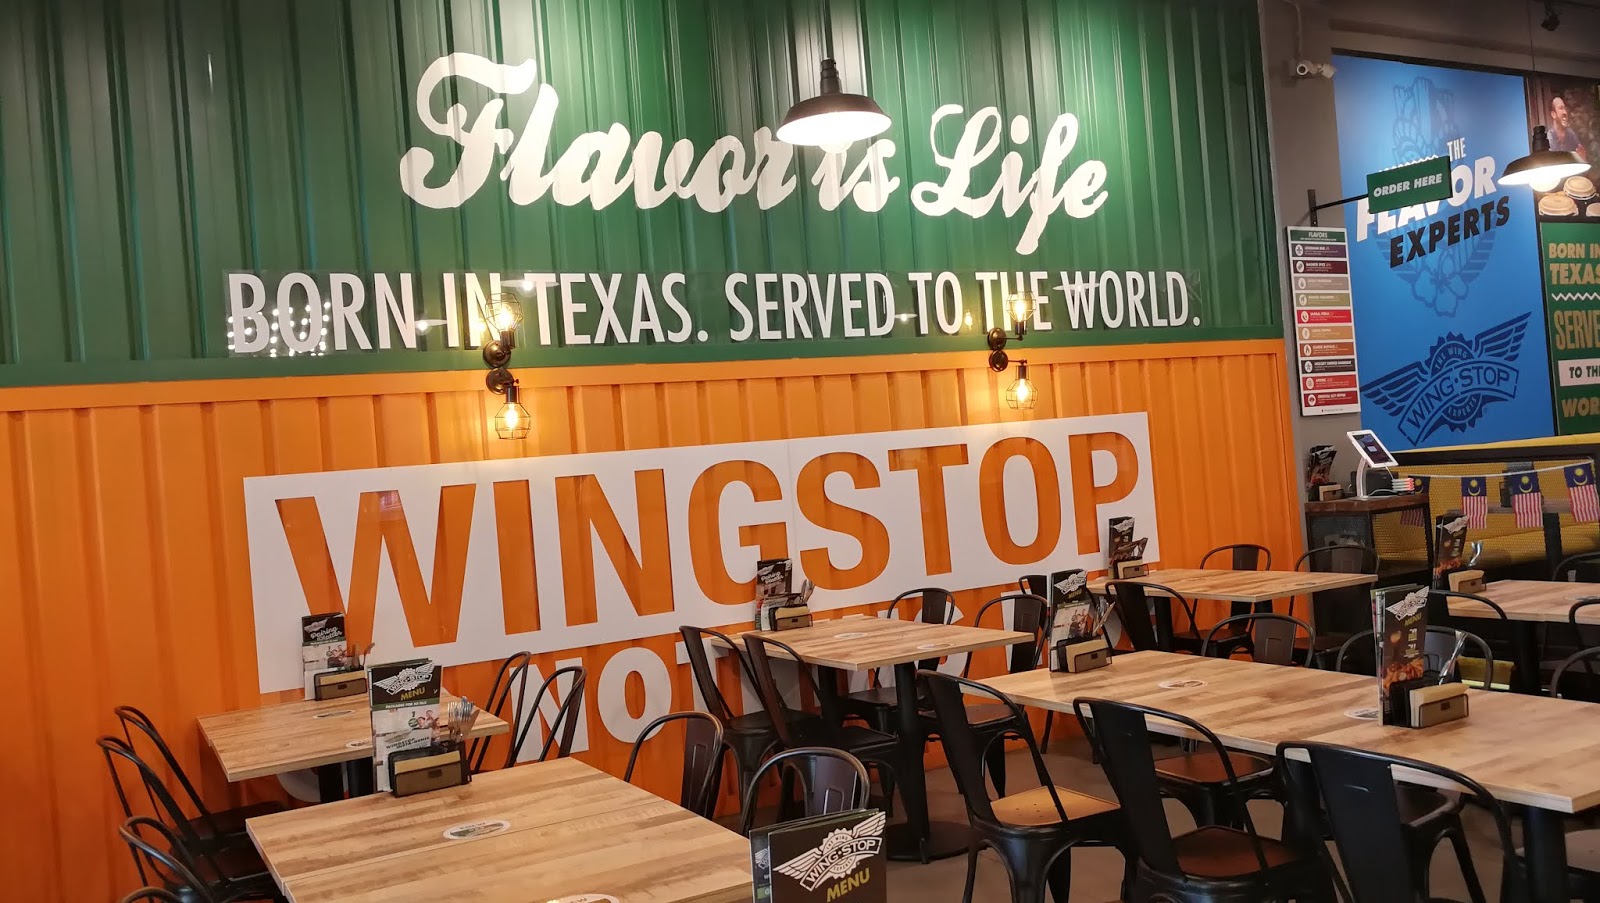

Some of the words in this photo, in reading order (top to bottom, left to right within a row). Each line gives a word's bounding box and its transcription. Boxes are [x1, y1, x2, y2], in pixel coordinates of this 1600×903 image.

[400, 52, 796, 213] Flavor
[911, 104, 1108, 255] Life
[1447, 138, 1466, 161] THE
[1373, 180, 1411, 197] ORDER
[1414, 173, 1443, 189] HERE
[1390, 196, 1510, 269] EXPERTS
[1549, 243, 1585, 259] BORN
[228, 272, 416, 353] BORN
[443, 272, 505, 348] IN
[524, 272, 709, 346] TEXAS.
[725, 272, 896, 342] SERVED
[908, 271, 963, 334] TO
[975, 271, 1052, 333] THE
[1060, 270, 1200, 329] WORLD.
[1448, 347, 1468, 358] WING
[1569, 366, 1582, 379] TO
[1586, 365, 1600, 378] TH
[1448, 396, 1476, 416] EXPERTS
[276, 432, 1139, 648] WINGSTOP
[401, 686, 425, 700] MENU
[826, 867, 871, 902] MENU
